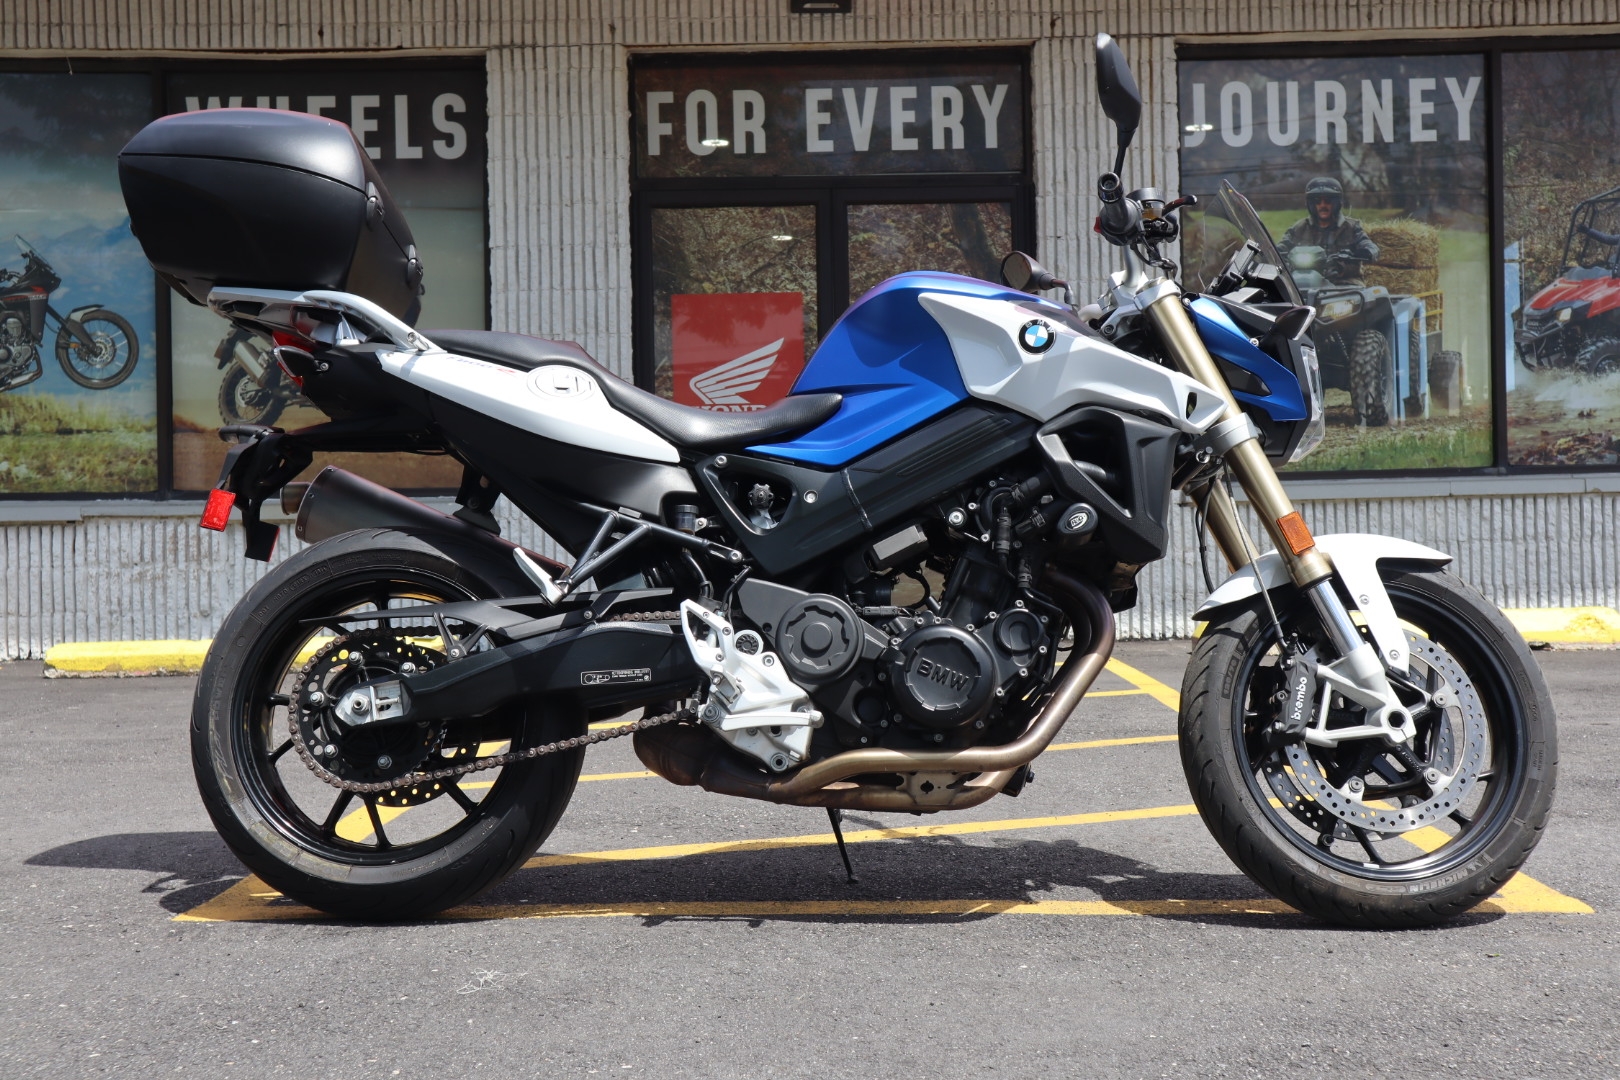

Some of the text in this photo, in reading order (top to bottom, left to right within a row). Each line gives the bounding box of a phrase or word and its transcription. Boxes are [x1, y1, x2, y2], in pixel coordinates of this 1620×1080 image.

[185, 93, 467, 159] ELS
[646, 84, 1009, 156] FOR EVERY
[1184, 76, 1482, 148] JOURNEY
[917, 657, 969, 692] BMW
[1291, 677, 1308, 720] brembo
